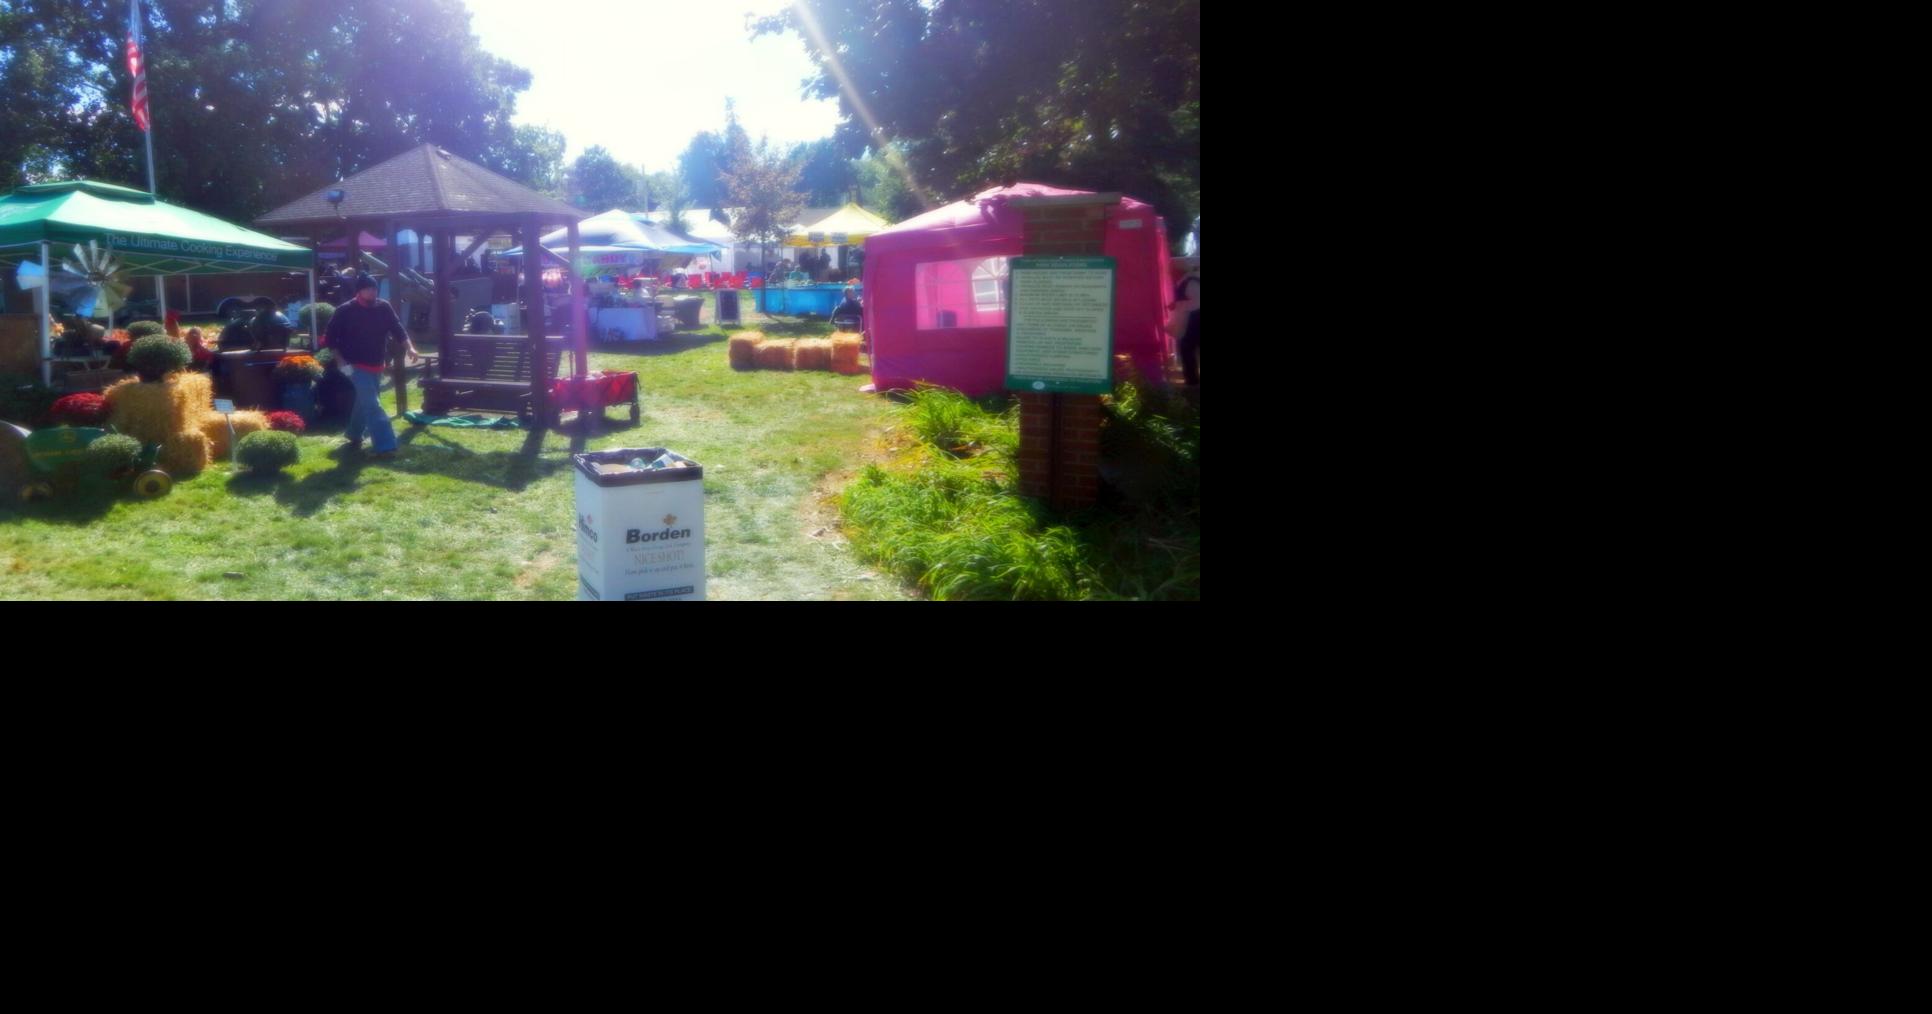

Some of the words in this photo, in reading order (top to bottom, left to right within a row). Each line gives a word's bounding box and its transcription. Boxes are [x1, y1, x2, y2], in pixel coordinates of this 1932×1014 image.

[105, 233, 128, 246] The
[131, 235, 178, 250] Ultimate
[181, 240, 223, 258] Cooking
[225, 245, 279, 262] Experience
[625, 528, 691, 544] Borden
